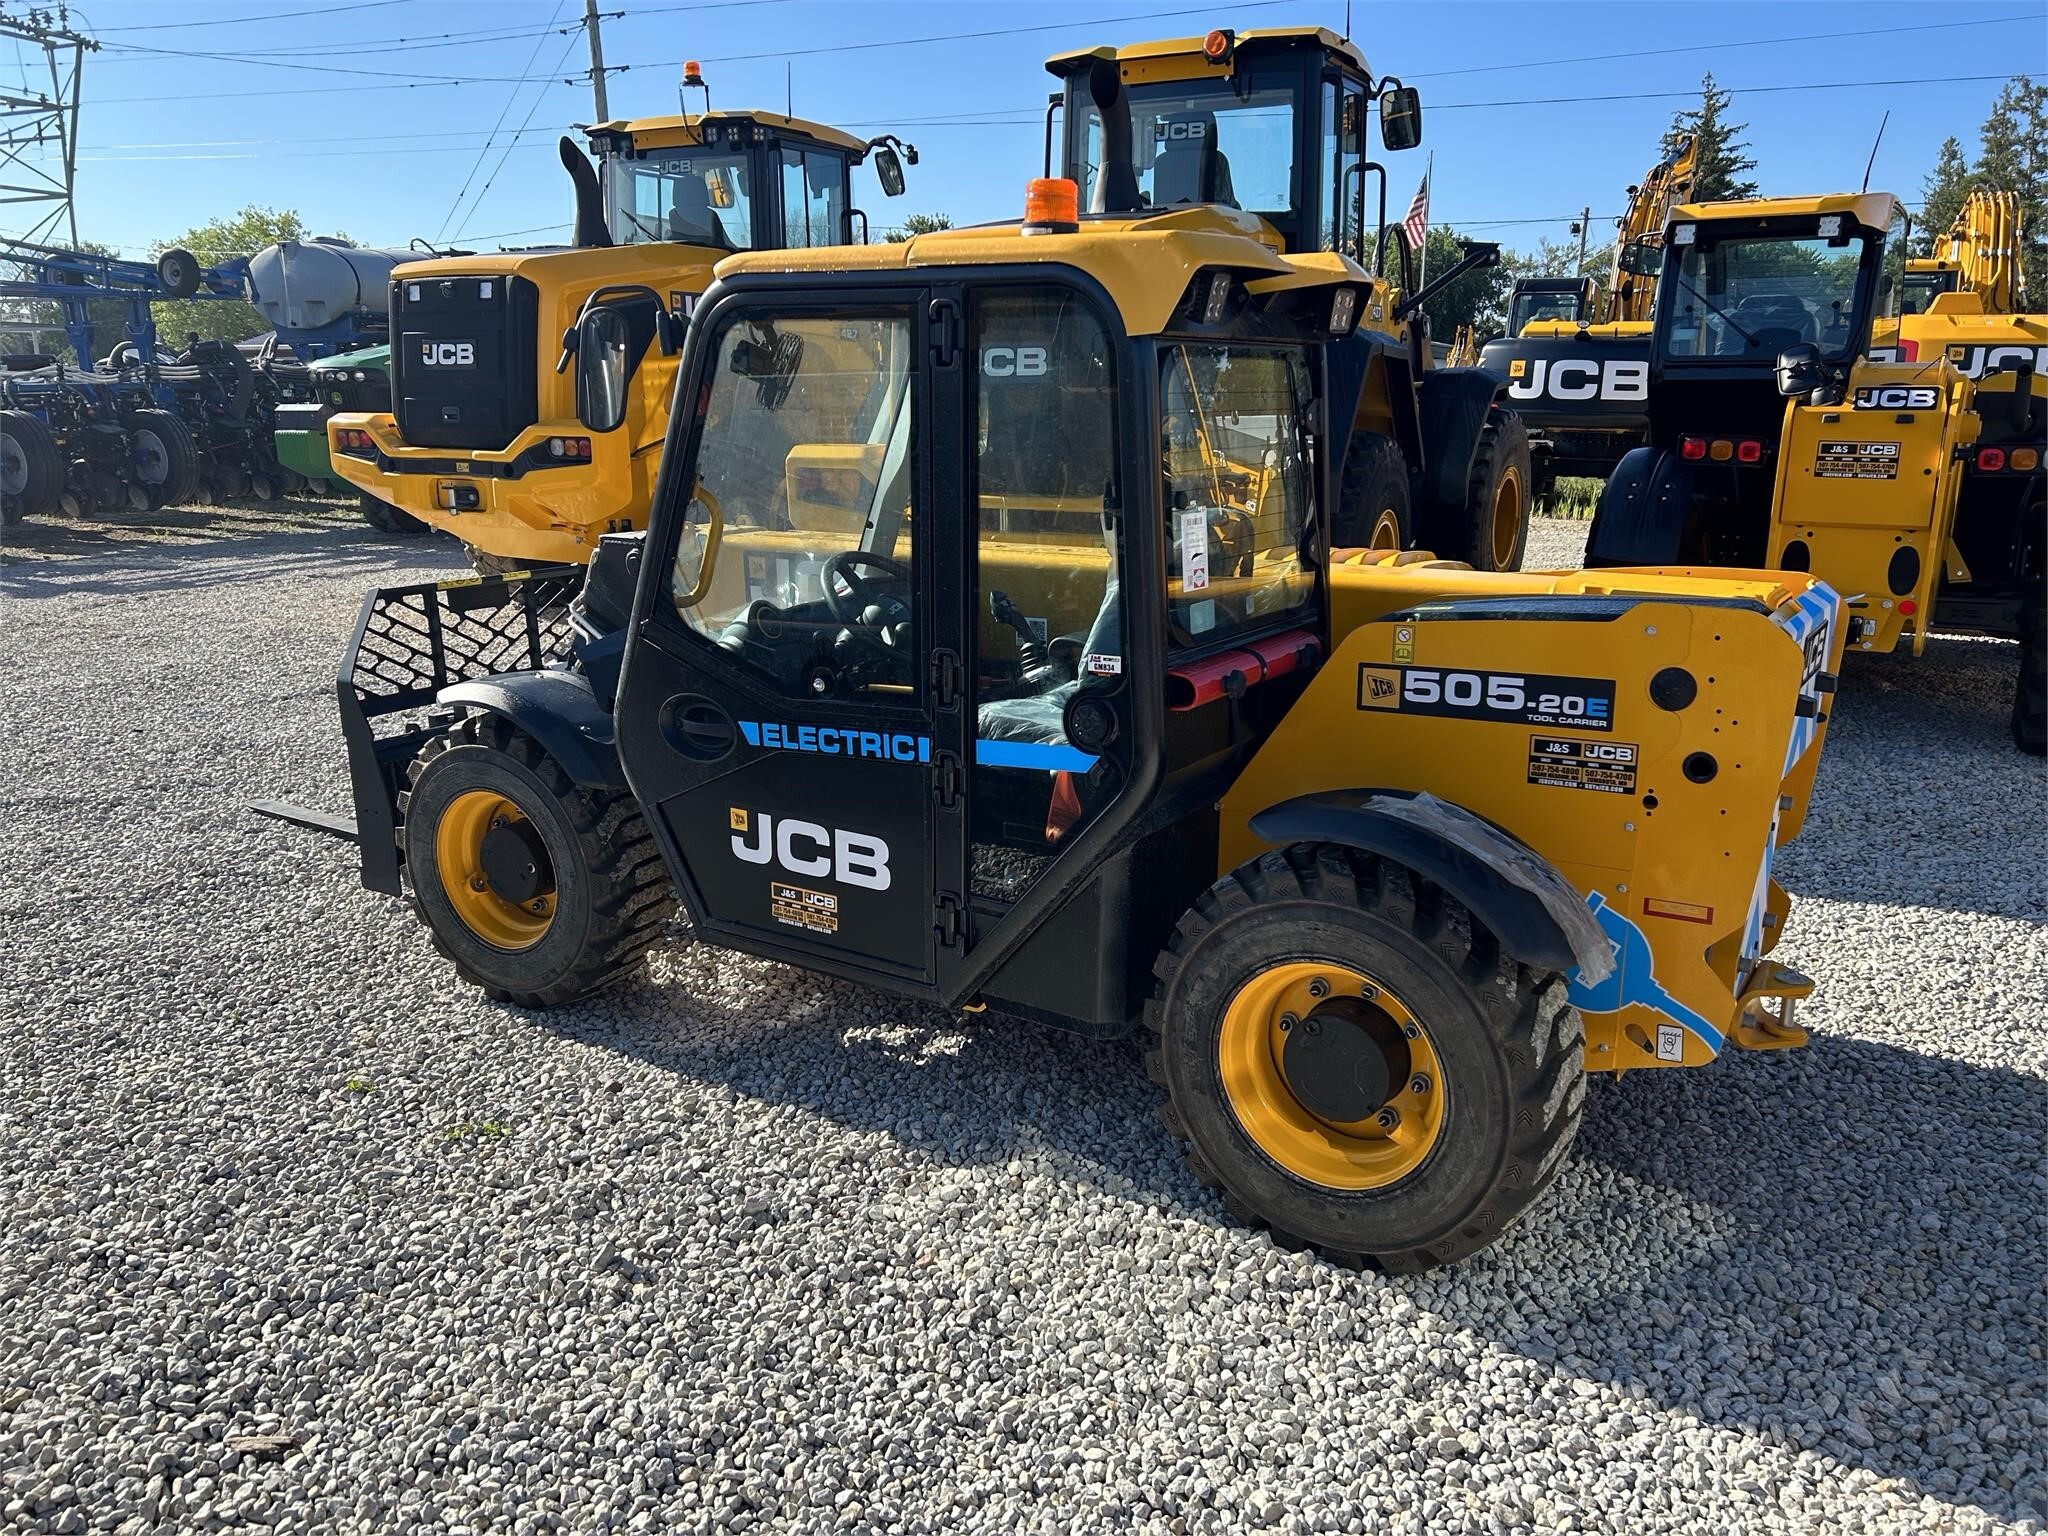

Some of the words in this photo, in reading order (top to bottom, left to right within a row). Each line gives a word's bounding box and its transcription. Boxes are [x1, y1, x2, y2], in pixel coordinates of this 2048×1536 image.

[1155, 121, 1205, 139] JCB
[660, 160, 691, 173] JCB
[841, 328, 858, 339] 427
[422, 343, 474, 365] JCB
[979, 347, 1047, 377] CB
[1508, 359, 1649, 400] JCB
[1857, 389, 1936, 408] JCB
[1830, 445, 1849, 453] J&S
[1860, 445, 1896, 455] JCB
[1371, 678, 1394, 697] JCB
[1527, 714, 1555, 723] TOOL
[1558, 716, 1607, 728] CARRIER
[761, 722, 915, 762] ELECTRIC
[1546, 743, 1570, 753] J&S
[1585, 745, 1632, 761] JCB
[731, 812, 891, 891] JCB
[781, 888, 796, 899] J&S
[805, 894, 835, 909] JCB
